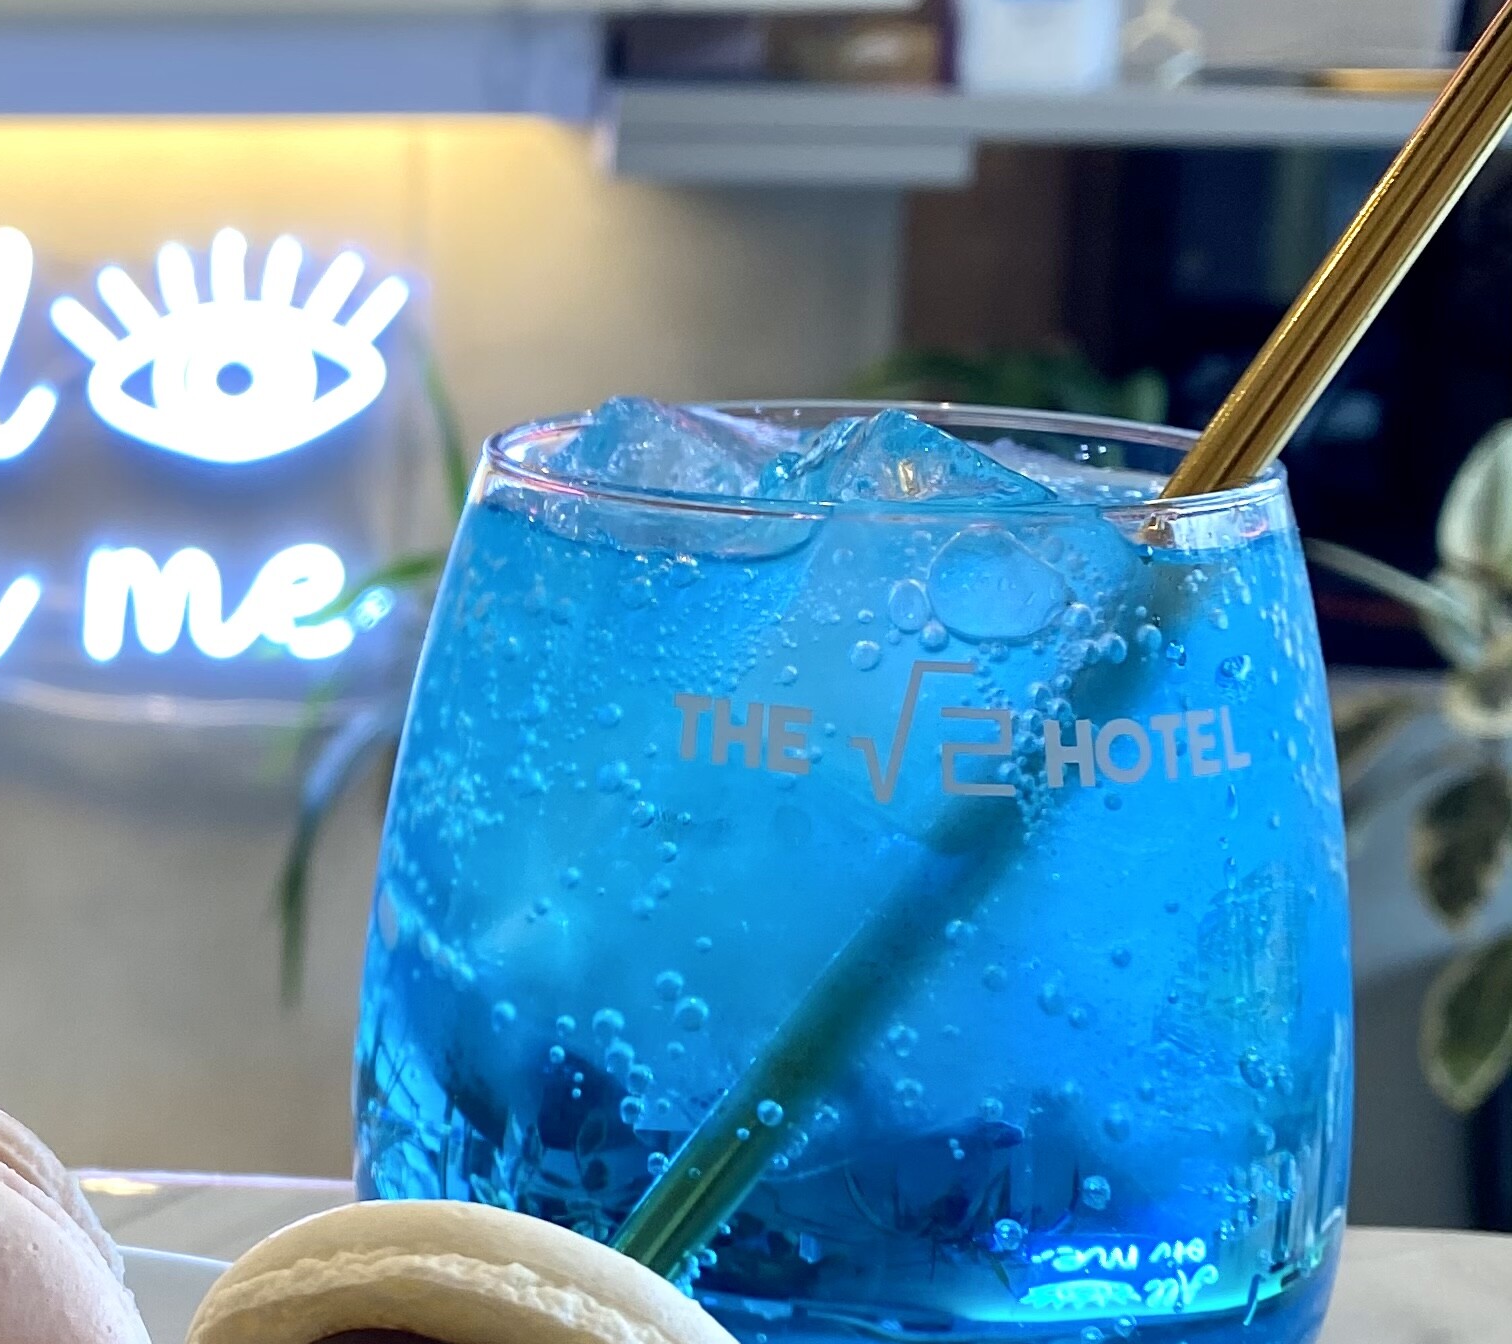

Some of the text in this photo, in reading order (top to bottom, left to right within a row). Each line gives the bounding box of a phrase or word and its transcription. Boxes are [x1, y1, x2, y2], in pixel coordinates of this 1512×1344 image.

[83, 542, 394, 663] me
[673, 692, 813, 776] THE
[1042, 704, 1253, 790] HOTEL
